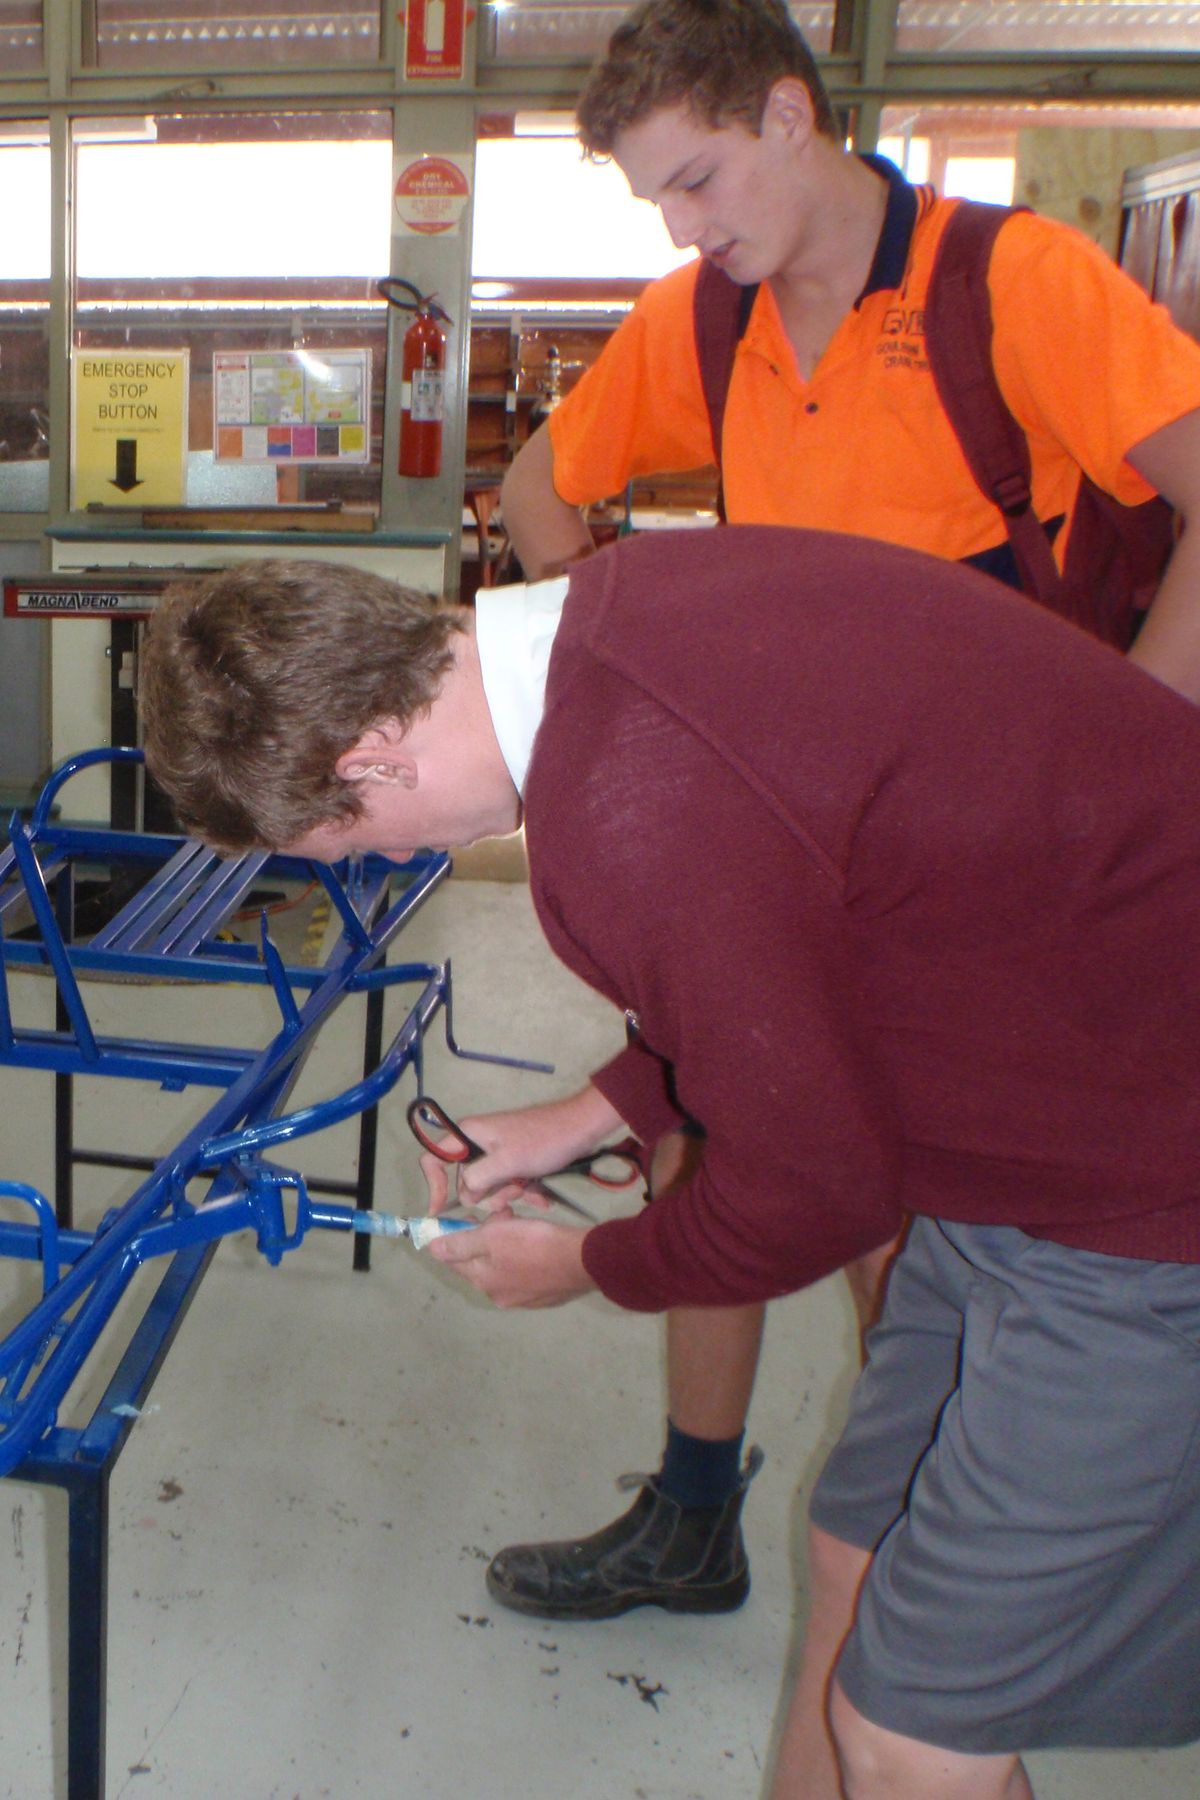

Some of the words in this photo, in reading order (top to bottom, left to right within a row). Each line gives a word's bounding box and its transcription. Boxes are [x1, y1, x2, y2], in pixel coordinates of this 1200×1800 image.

[82, 363, 176, 378] EMERGENCY
[109, 384, 148, 399] STOP
[98, 404, 158, 420] BUTTON
